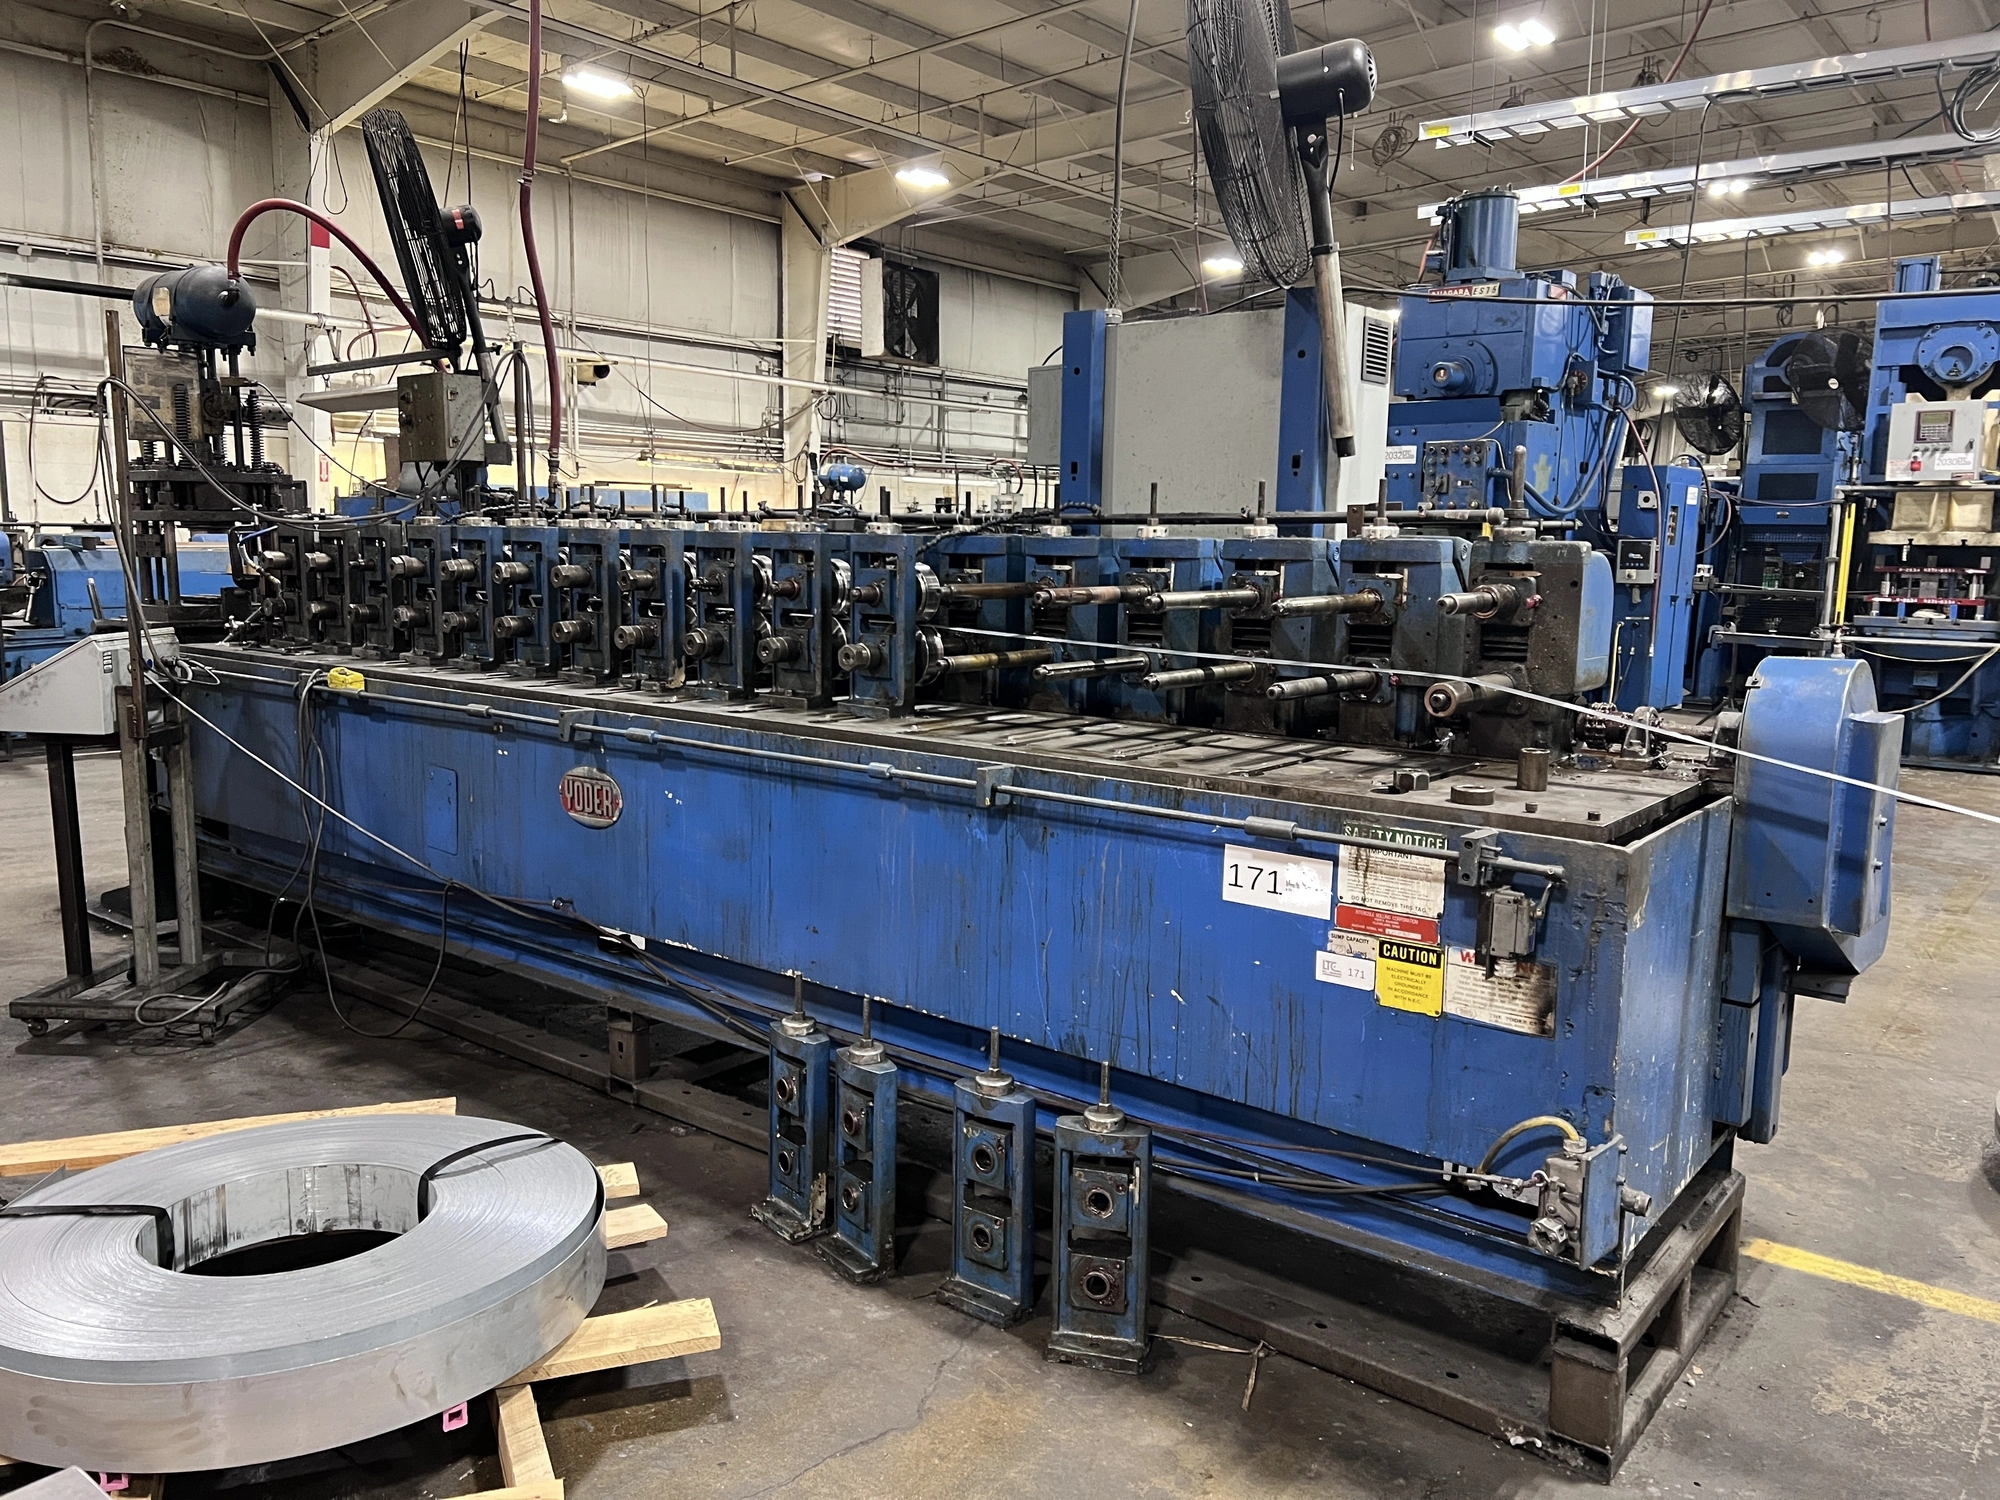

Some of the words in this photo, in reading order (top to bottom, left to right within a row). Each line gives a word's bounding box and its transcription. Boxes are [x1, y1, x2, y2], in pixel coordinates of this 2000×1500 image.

[1431, 288, 1470, 297] AGARA
[564, 778, 613, 818] YODER
[1396, 832, 1443, 849] NOTICE
[1375, 898, 1398, 908] REMOVE
[1400, 902, 1413, 911] THIS
[1346, 935, 1370, 944] CAPACITY
[1383, 943, 1437, 966] CAUTION
[1348, 967, 1366, 980] 171
[1386, 966, 1409, 975] MACHINE
[1391, 974, 1426, 985] ELECTRICALLY
[1394, 988, 1429, 999] ACCORDANCE
